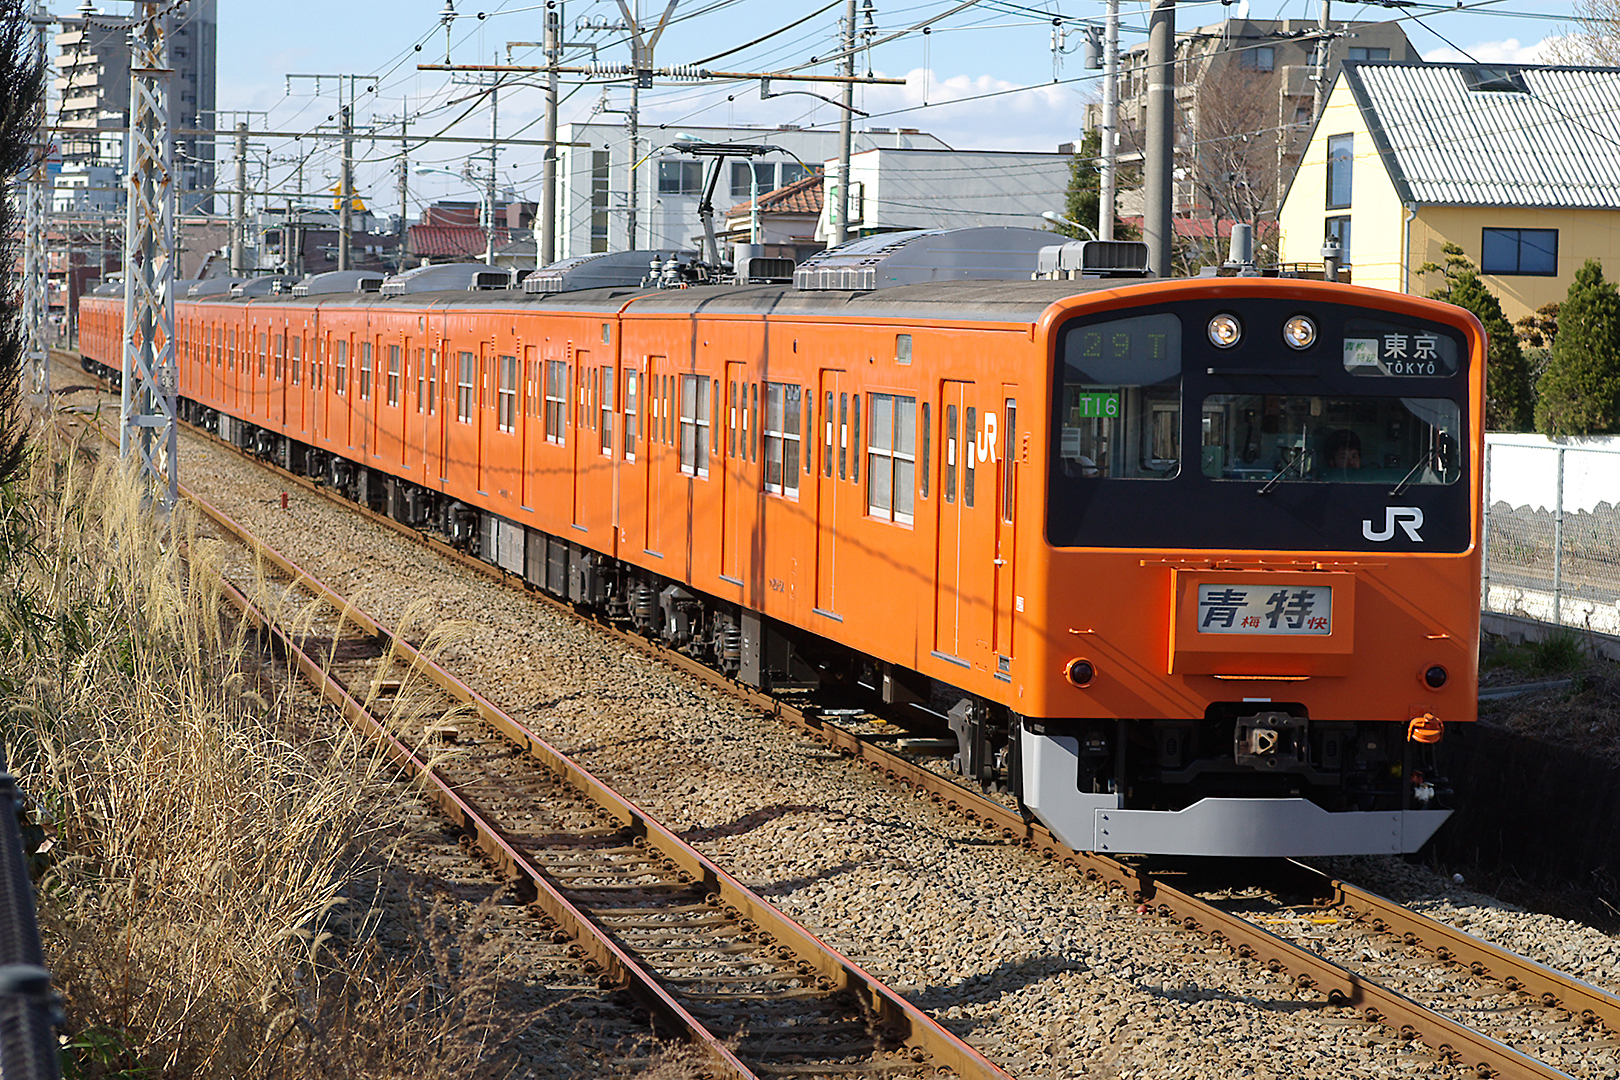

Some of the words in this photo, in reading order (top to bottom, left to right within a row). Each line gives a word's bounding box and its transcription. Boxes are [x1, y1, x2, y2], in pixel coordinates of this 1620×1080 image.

[1383, 332, 1438, 359] 東京
[1081, 397, 1117, 415] T16
[977, 412, 997, 464] JR
[1362, 506, 1424, 542] JR
